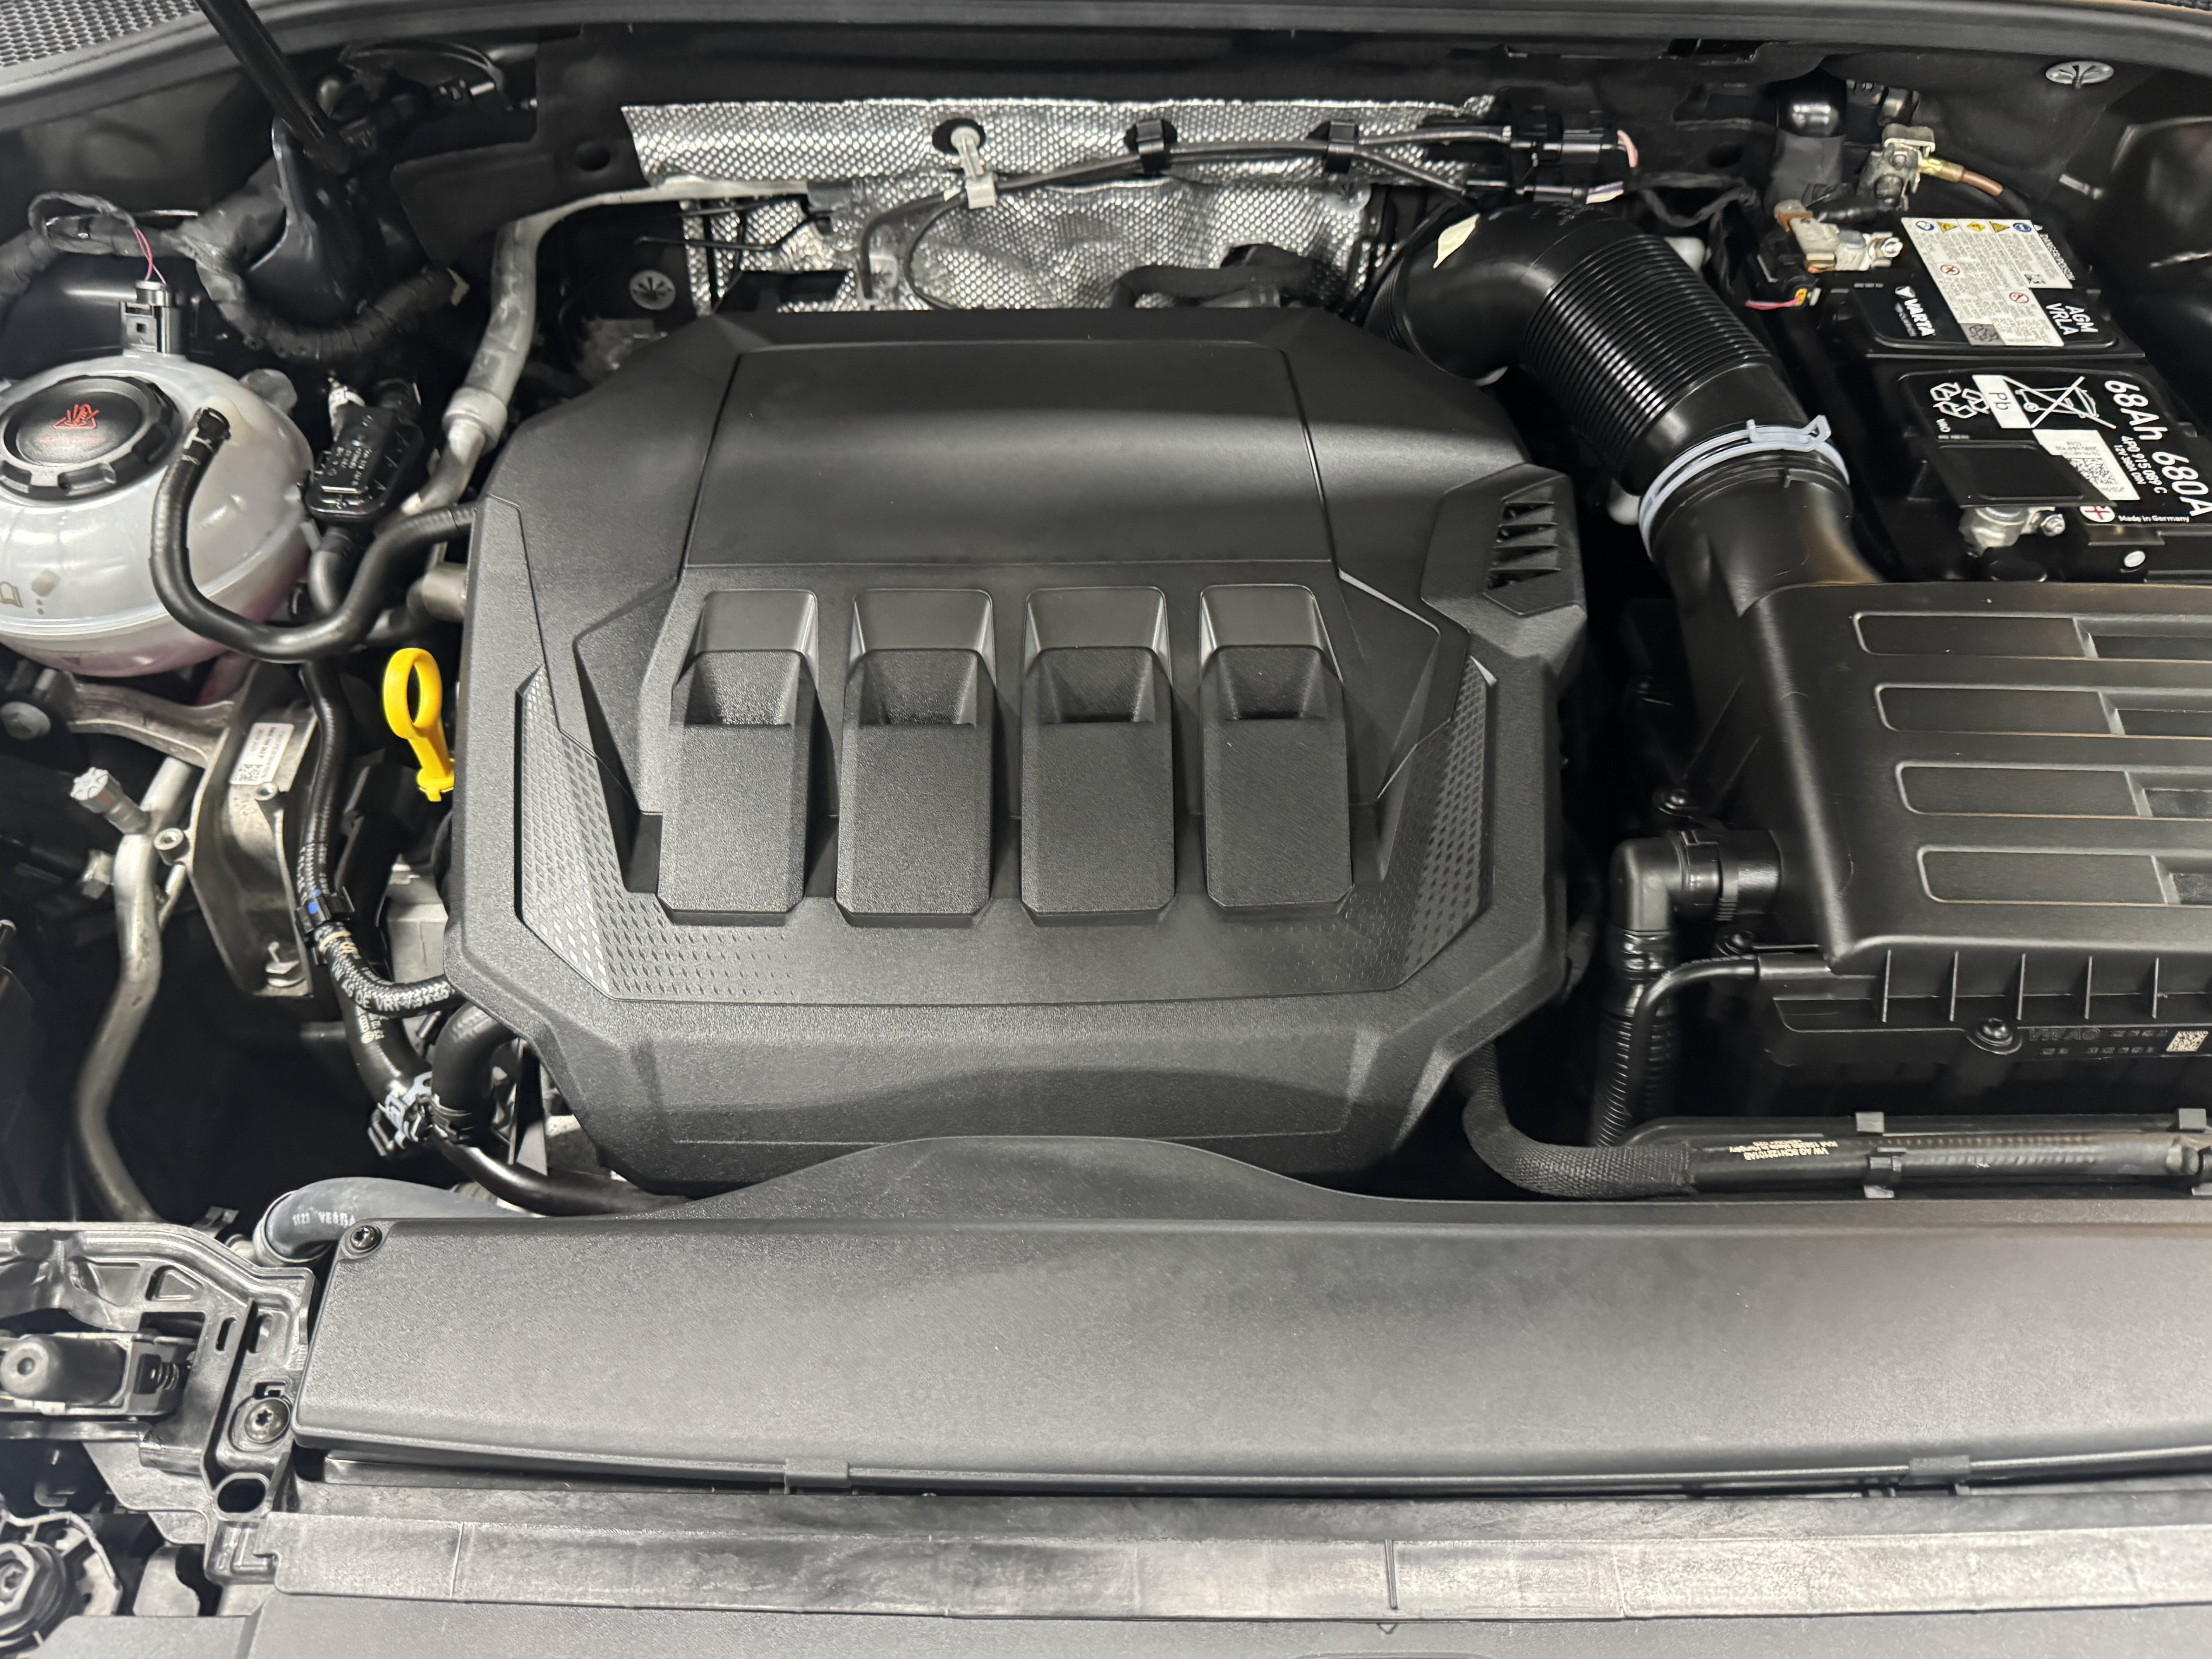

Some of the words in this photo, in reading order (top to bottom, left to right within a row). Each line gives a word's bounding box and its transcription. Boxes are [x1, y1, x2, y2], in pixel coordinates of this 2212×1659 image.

[1904, 299, 1934, 336] VARTA
[2046, 303, 2081, 335] VRLA
[2065, 305, 2099, 333] AGM
[1988, 392, 2009, 410] Pb
[2104, 380, 2168, 440] 68Ah
[2152, 452, 2212, 517] 680A
[2132, 453, 2151, 468] 915
[2152, 514, 2190, 523] Germany
[1813, 1146, 1829, 1155] VW
